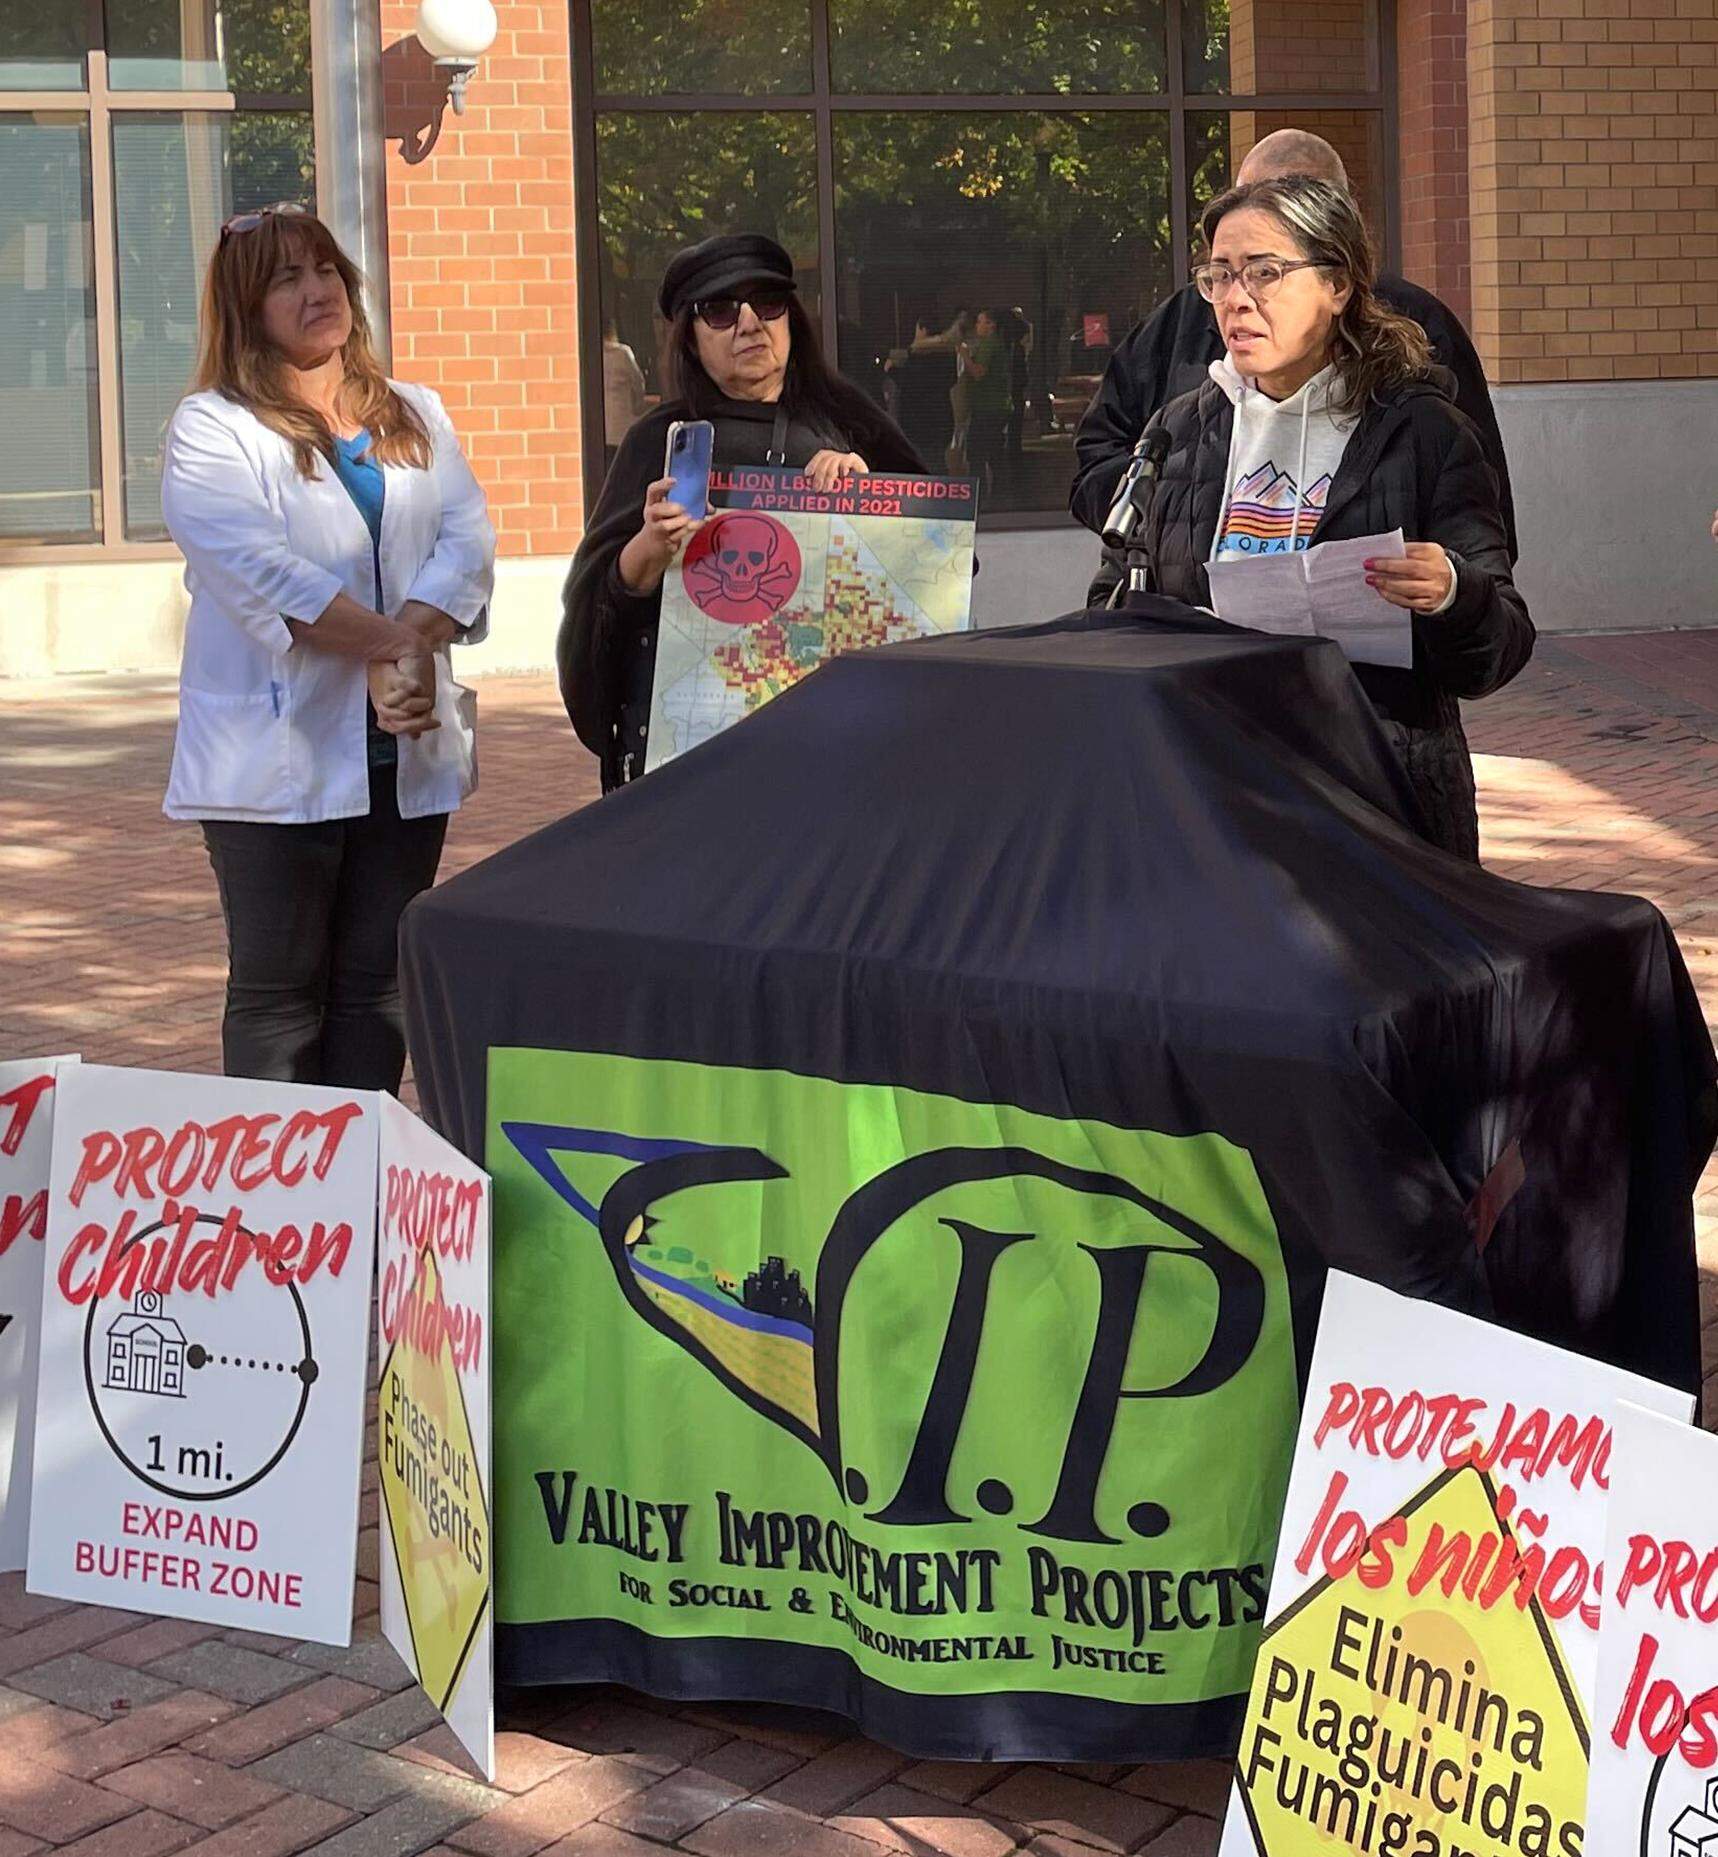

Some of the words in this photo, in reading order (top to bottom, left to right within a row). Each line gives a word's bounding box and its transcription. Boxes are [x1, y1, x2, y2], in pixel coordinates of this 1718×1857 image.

[710, 471, 775, 490] ILLION
[859, 478, 970, 499] PESTICIDES
[752, 494, 830, 511] APPLIED
[836, 497, 854, 512] IN
[861, 499, 902, 514] 2021
[69, 1103, 363, 1208] PROTECT
[57, 1199, 353, 1305] Children
[384, 1164, 483, 1263] PROTECT
[147, 1435, 165, 1471] 1
[178, 1441, 233, 1481] mi.
[391, 1370, 437, 1461] Phase
[441, 1438, 470, 1500] out
[122, 1503, 258, 1552] EXPAND
[385, 1410, 483, 1575] Fumigants
[1294, 1470, 1408, 1590] los
[75, 1541, 201, 1592] BUFFER
[210, 1562, 303, 1608] ZONE
[534, 1470, 690, 1563] VALLEY
[715, 1491, 1000, 1614] IMPROVEMENT
[1026, 1546, 1269, 1647] PROJECTS
[619, 1571, 653, 1604] FOR
[668, 1579, 771, 1611] SOCIAL
[788, 1588, 815, 1614] &
[829, 1591, 1034, 1664] ENVIRONMENTAL
[1051, 1634, 1167, 1675] JUSTICE
[1330, 1605, 1545, 1772] Elimina
[1610, 1633, 1718, 1769] los
[1262, 1655, 1585, 1857] Plaguicidas
